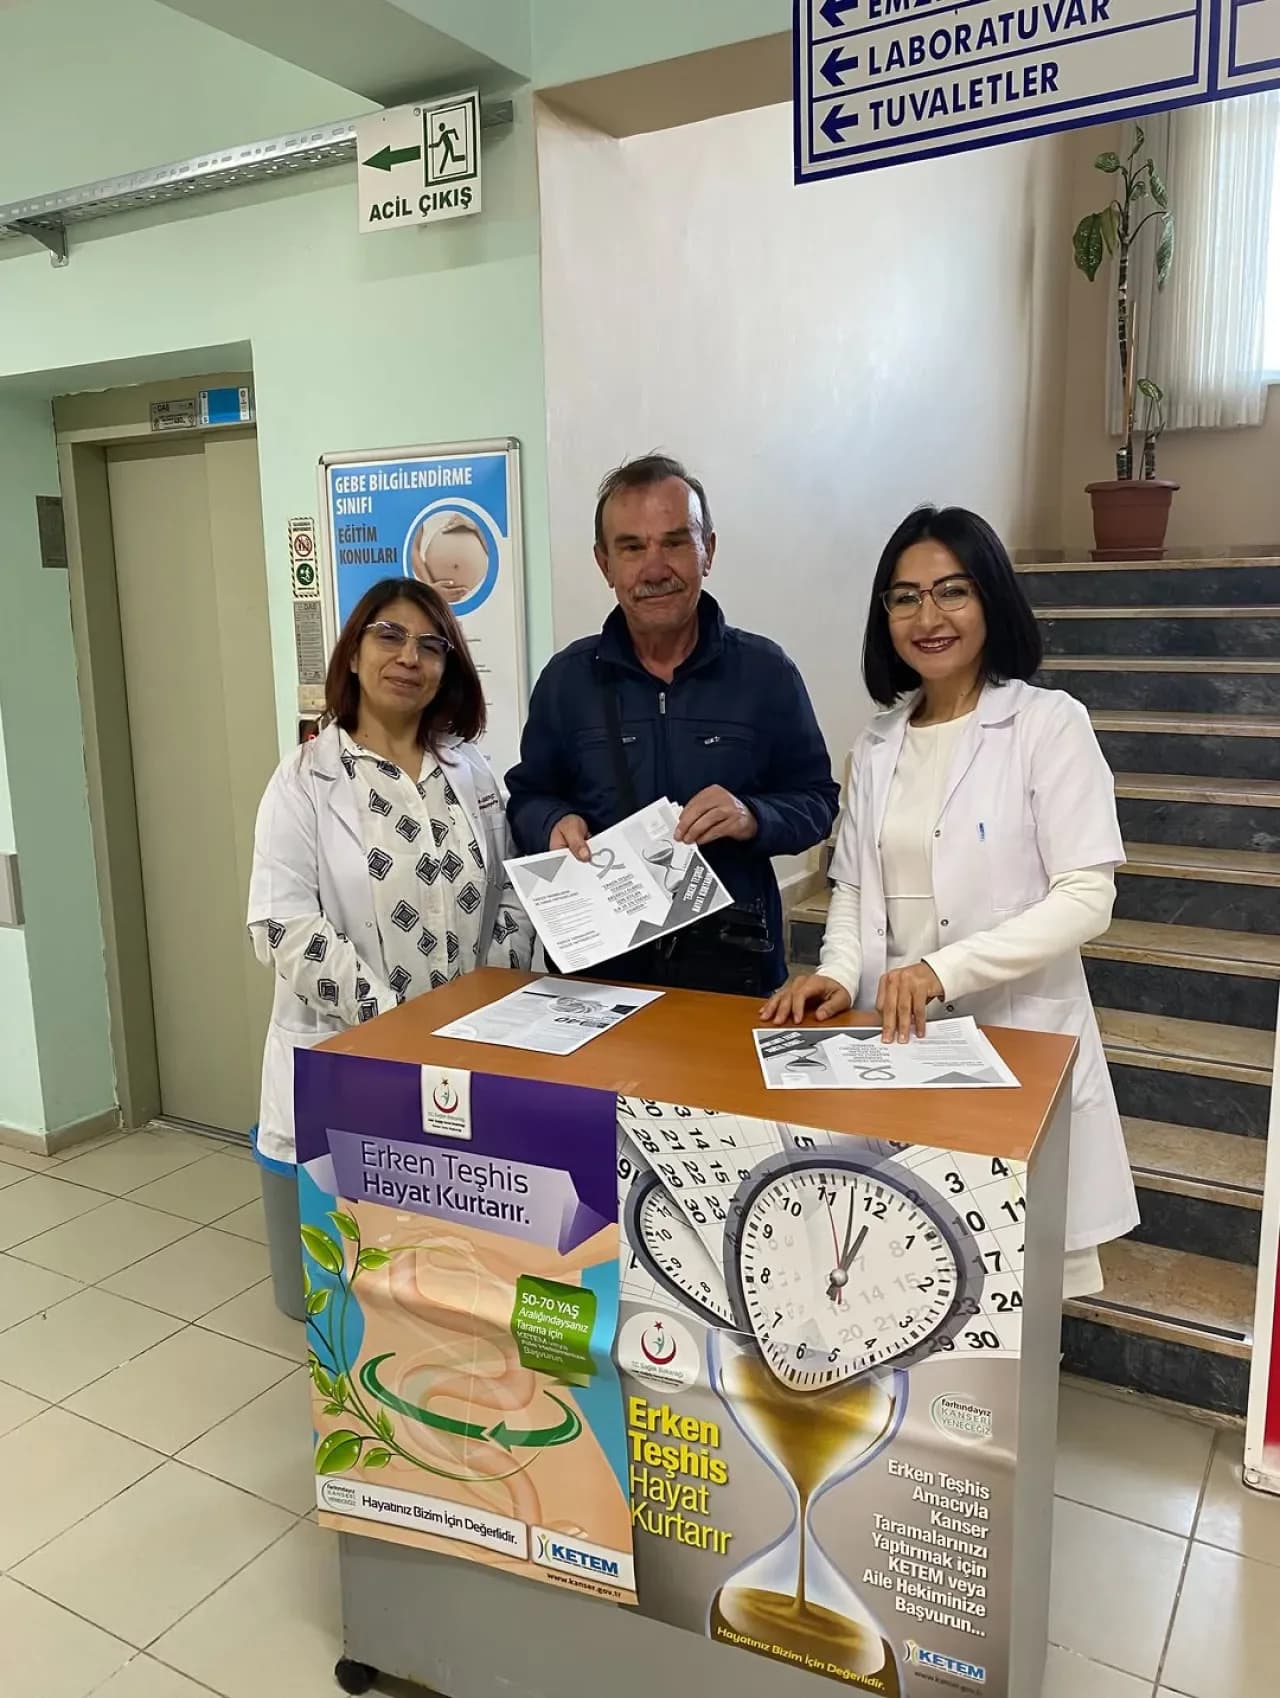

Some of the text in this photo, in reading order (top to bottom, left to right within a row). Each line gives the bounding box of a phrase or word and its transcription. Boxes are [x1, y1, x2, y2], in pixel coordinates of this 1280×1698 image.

[868, 0, 1110, 76] LABORATUVAR
[869, 61, 1059, 131] TUVALETLER
[369, 185, 473, 223] ACİL ÇIKIŞ
[335, 466, 473, 494] GEBE BİLGİLENDİRME
[336, 496, 372, 515] SINIFI
[338, 522, 377, 544] EĞİTİM
[339, 547, 398, 566] KONULARI
[632, 1127, 660, 1154] 28
[660, 1128, 686, 1151] 21
[688, 1127, 711, 1150] 14
[361, 1141, 529, 1194] Erken Teşhis
[657, 1162, 684, 1189] 29
[682, 1160, 706, 1185] 22
[710, 1159, 730, 1184] 15
[991, 1157, 1008, 1177] 4
[945, 1172, 965, 1193] 3
[363, 1171, 530, 1225] Hayat Kurtarır.
[683, 1198, 707, 1224] 30
[704, 1195, 727, 1221] 23
[782, 1197, 802, 1217] 10
[863, 1197, 888, 1220] 12
[762, 1223, 773, 1239] 9
[905, 1235, 916, 1250] 1
[760, 1267, 771, 1284] 8
[917, 1276, 935, 1293] 2
[522, 1292, 580, 1319] 50-70 YAŞ
[991, 1290, 1023, 1312] 24
[516, 1319, 563, 1340] Tarama için
[518, 1307, 589, 1333] Aralığındaysanız
[771, 1311, 783, 1328] 7
[898, 1315, 914, 1328] 3
[796, 1343, 807, 1360] 6
[864, 1337, 877, 1350] 4
[964, 1331, 1000, 1349] 30
[828, 1347, 841, 1363] 5
[628, 1395, 719, 1449] Erken
[628, 1430, 728, 1484] Teşhis
[630, 1464, 710, 1514] Hayat
[888, 1459, 991, 1500] Erken Teşhis
[912, 1485, 989, 1520] Amacıyla
[362, 1495, 413, 1517] Hayatınız
[413, 1505, 443, 1523] Bizim
[443, 1509, 463, 1529] İçin
[464, 1517, 518, 1545] Değerlidir.
[631, 1498, 732, 1555] Kurtarır
[930, 1509, 989, 1539] Kanser
[872, 1513, 988, 1559] Taramalarınızı
[552, 1543, 619, 1575] KETEM
[872, 1532, 987, 1579] Yaptırmak için
[888, 1557, 986, 1599] KETEM veya
[863, 1568, 986, 1618] Aile Hekiminize
[895, 1595, 986, 1637] Başvurun...
[717, 1626, 886, 1691] Hayatınız Bizim İçin Değerlidir.
[919, 1649, 984, 1679] KETEM
